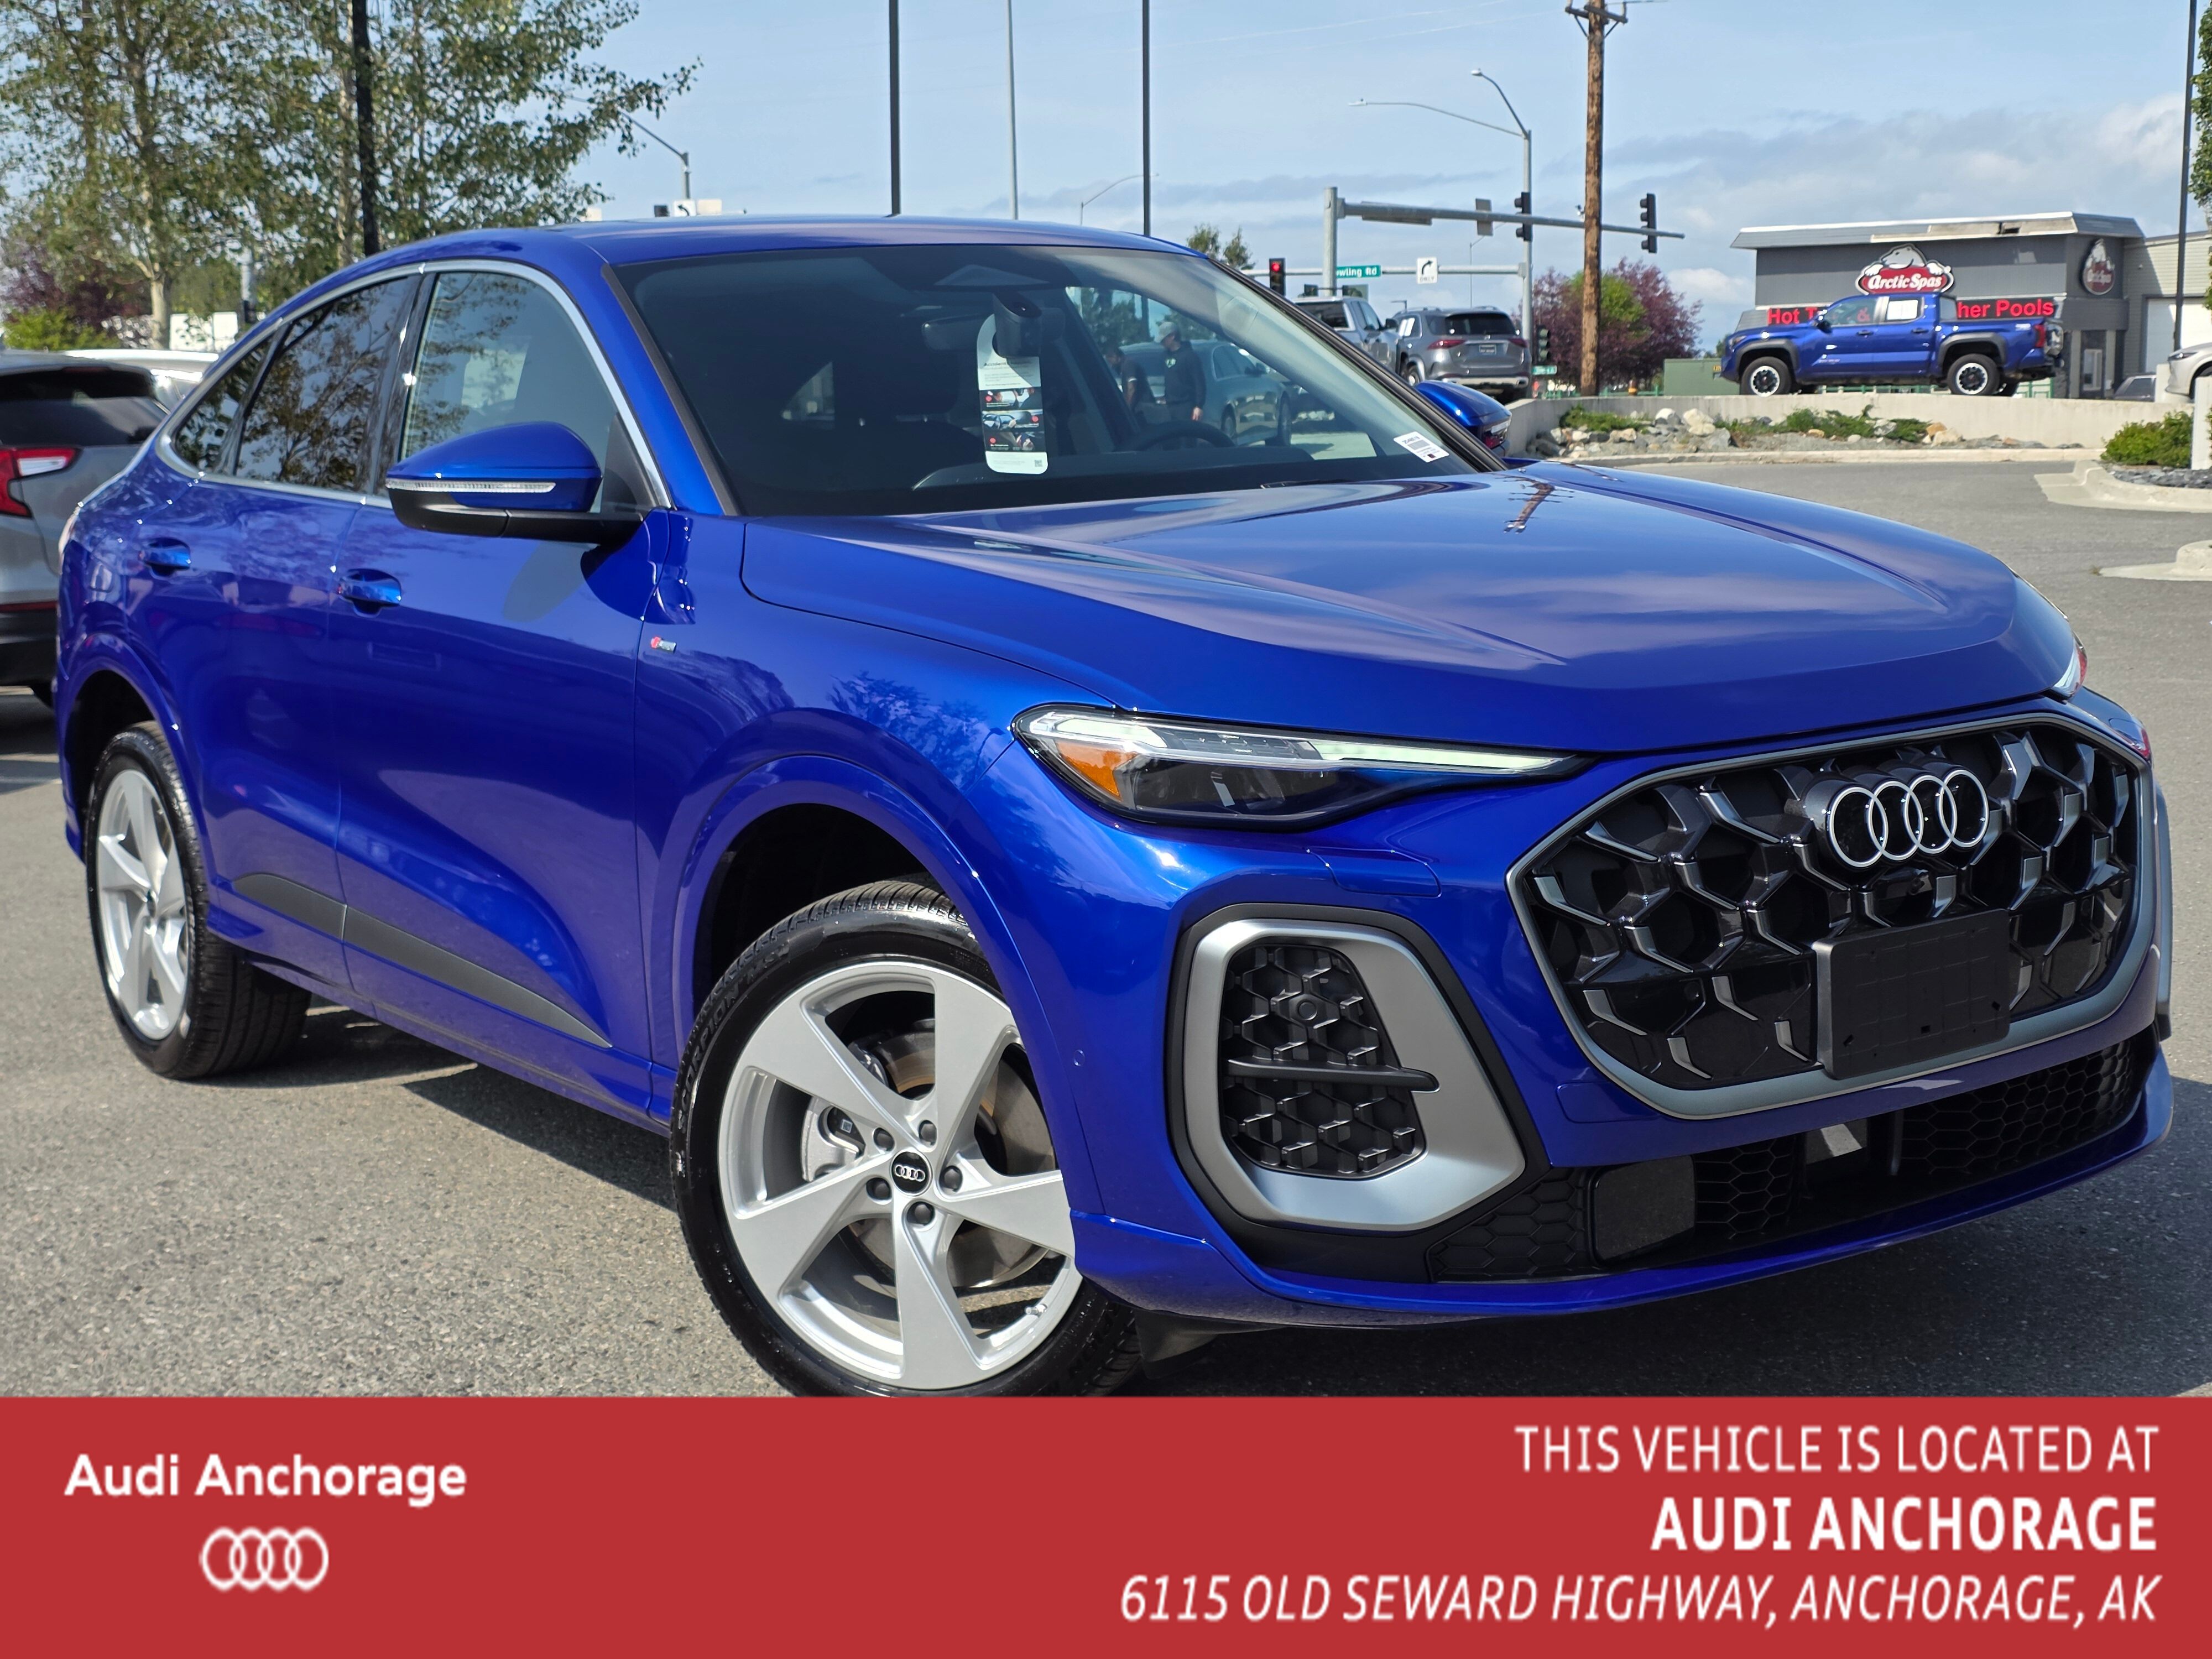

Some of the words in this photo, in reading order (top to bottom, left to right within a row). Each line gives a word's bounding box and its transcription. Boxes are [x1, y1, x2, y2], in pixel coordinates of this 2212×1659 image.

[1336, 268, 1362, 278] owling
[1366, 267, 1377, 275] Rd
[1909, 273, 1942, 290] Spas
[1767, 307, 1799, 324] Hot
[1957, 301, 1990, 318] her
[1996, 298, 2054, 317] Pools
